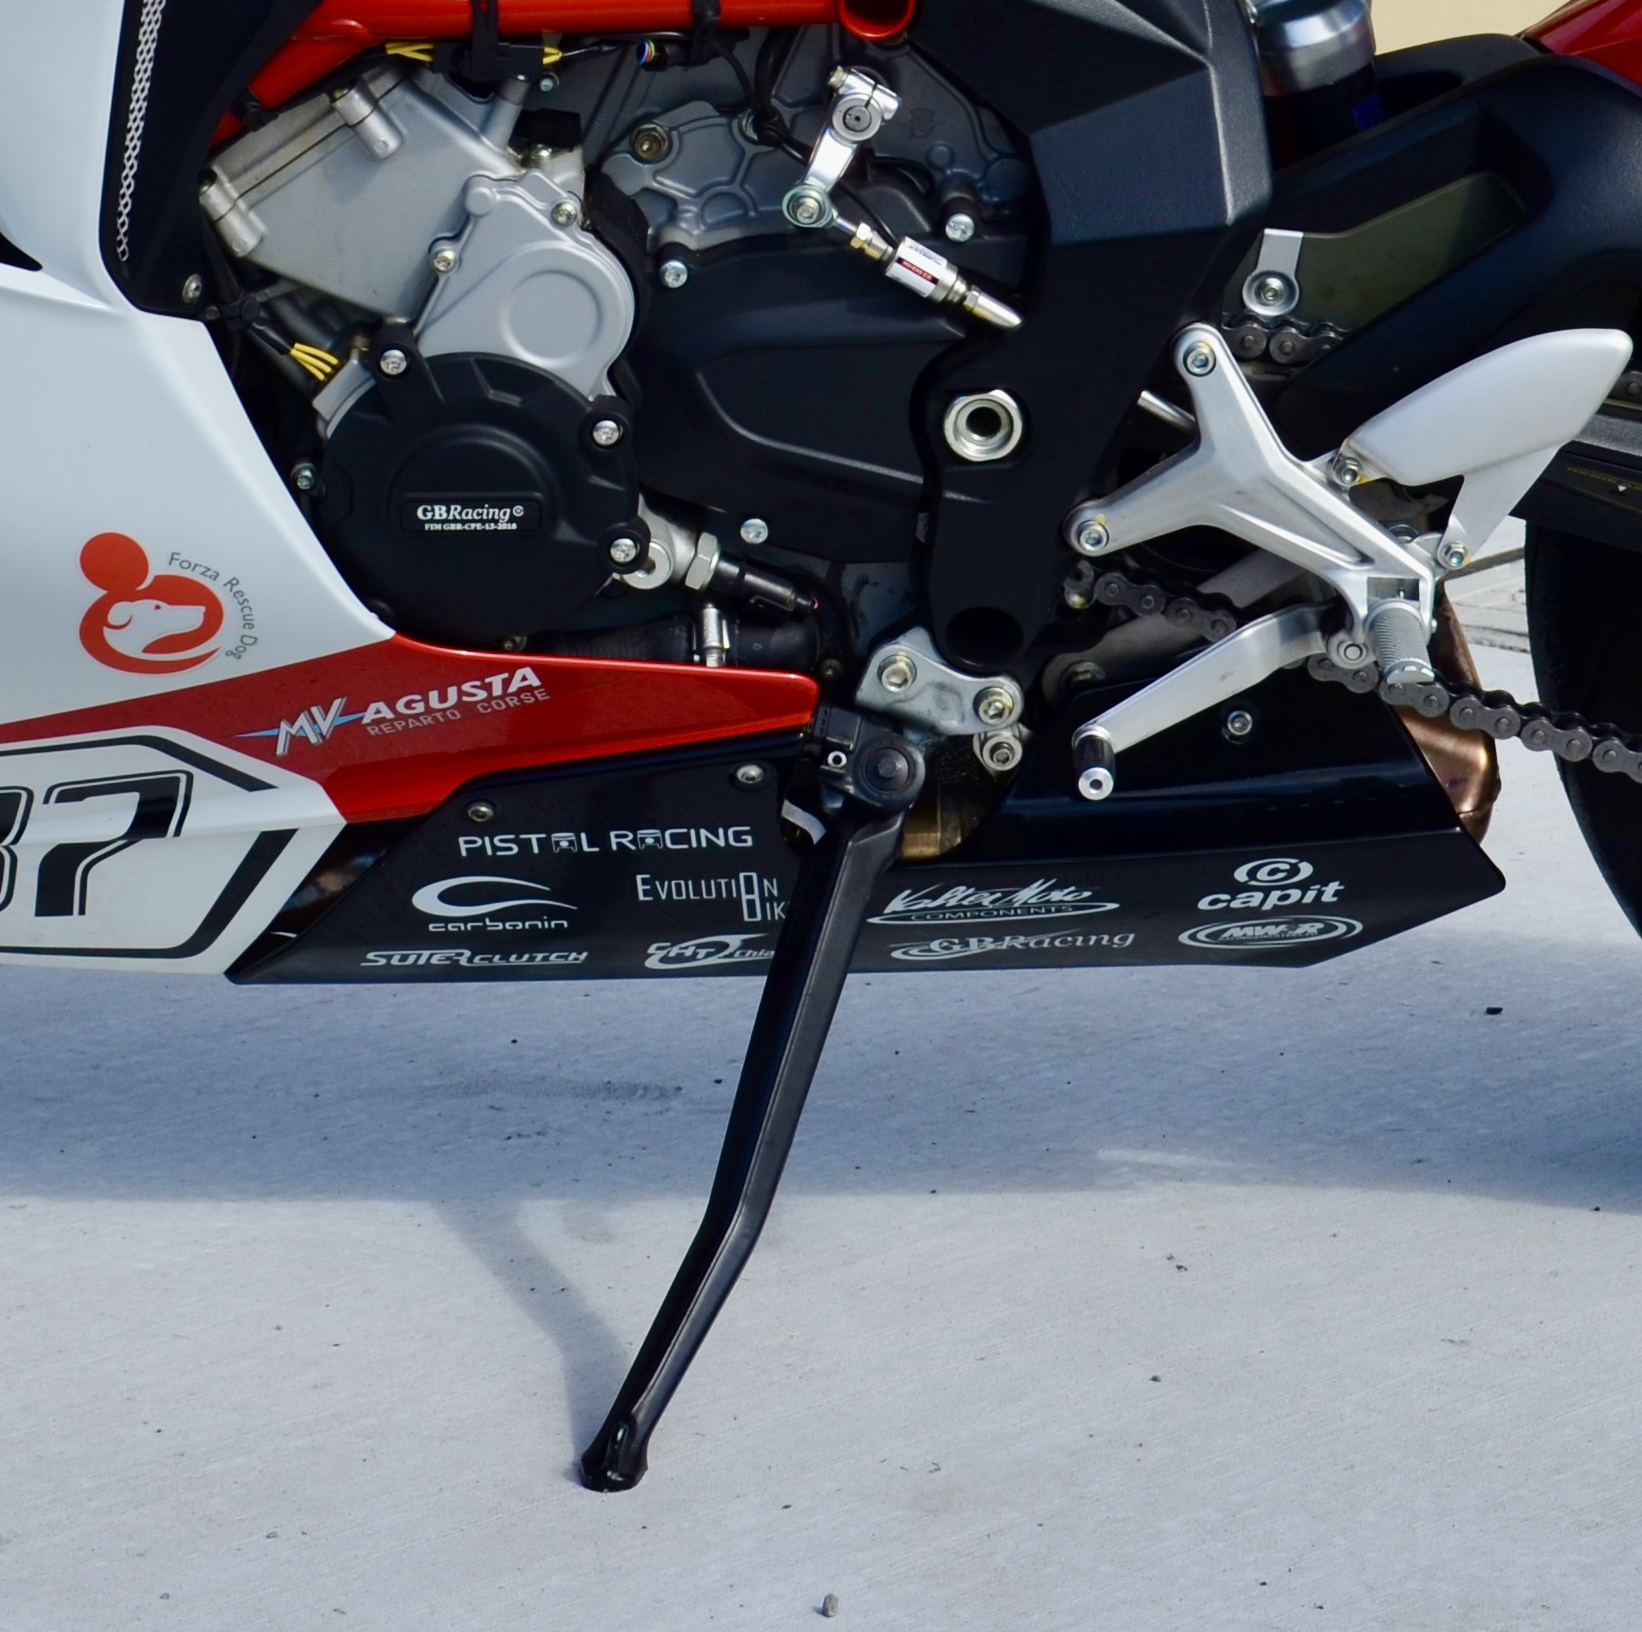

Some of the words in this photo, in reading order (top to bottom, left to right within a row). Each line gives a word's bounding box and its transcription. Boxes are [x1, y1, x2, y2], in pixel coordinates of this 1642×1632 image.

[168, 551, 220, 582] Forza
[222, 576, 255, 631] Rescue
[224, 634, 258, 660] Dog
[275, 696, 347, 757] MV
[361, 666, 542, 725] AGUSTA
[366, 708, 462, 737] REPARTO
[476, 687, 551, 715] CORSE
[1196, 880, 1347, 912] capit
[428, 916, 568, 933] carbonin
[910, 905, 1074, 922] COMPONENTS
[929, 931, 1136, 954] GBRacing
